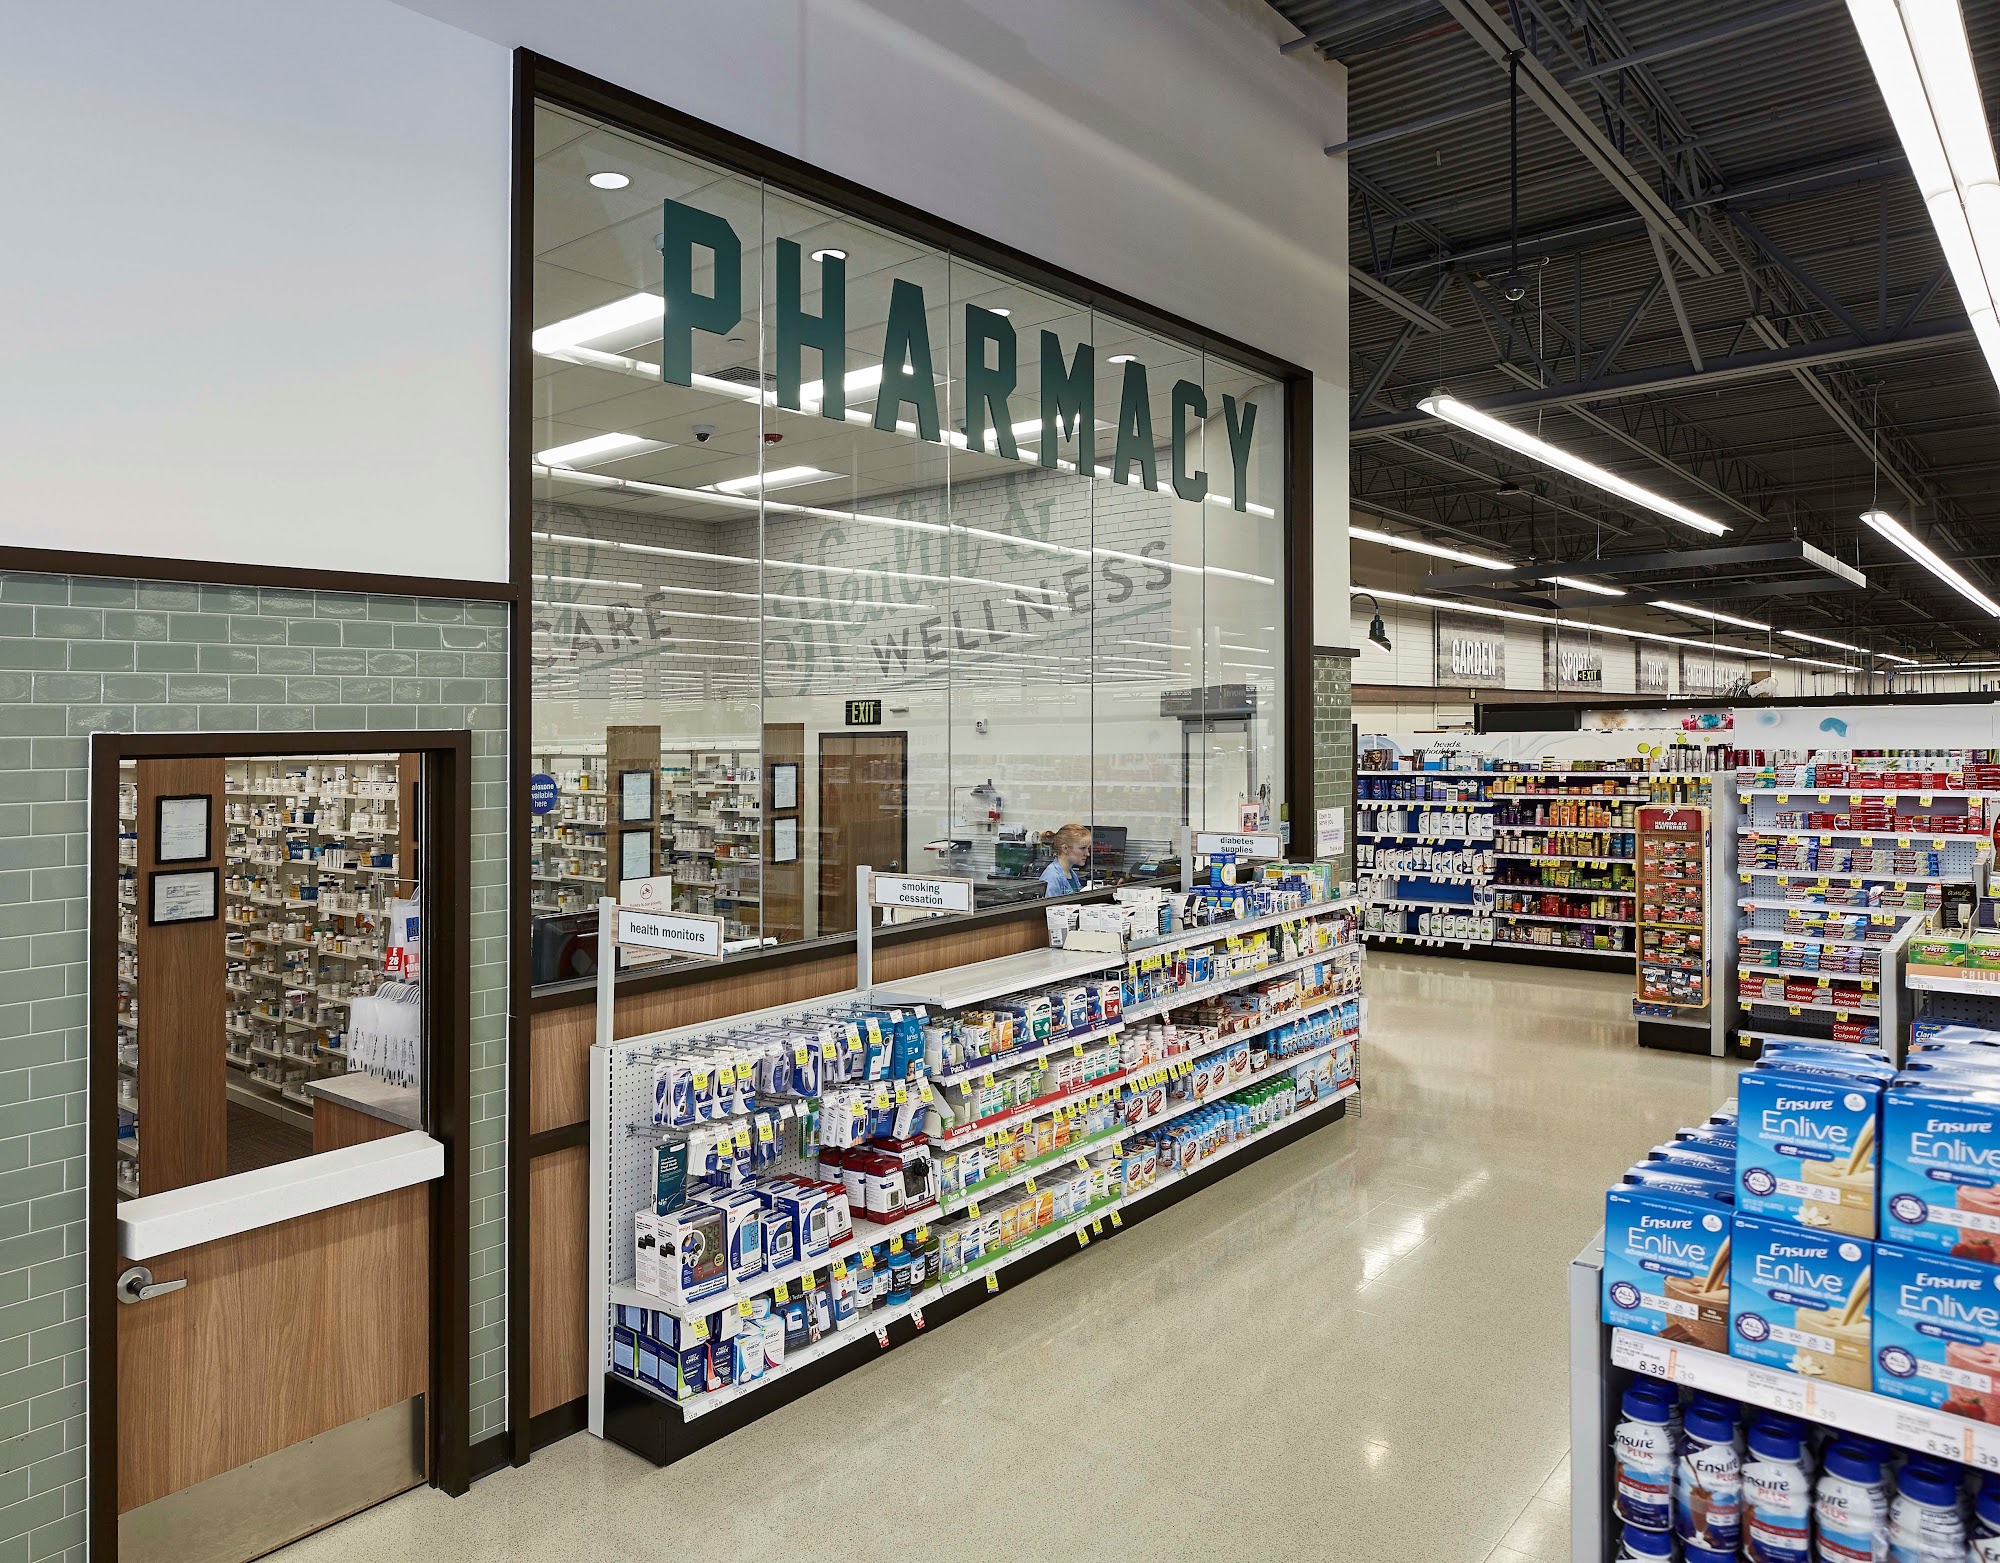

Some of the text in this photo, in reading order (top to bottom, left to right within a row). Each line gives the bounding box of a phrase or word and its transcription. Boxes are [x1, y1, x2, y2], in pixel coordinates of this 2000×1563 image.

[663, 198, 1258, 512] PHARMACY
[764, 485, 981, 698] Health
[1001, 470, 1073, 562] &
[870, 540, 1171, 679] WELLNESS
[532, 592, 672, 666] CARE
[1452, 639, 1496, 676] GARDEN
[1582, 671, 1597, 681] EXIT
[1648, 660, 1663, 686] TOYS
[852, 701, 876, 724] EXIT
[1220, 837, 1254, 845] diabetes
[902, 882, 940, 894] smoking
[899, 894, 943, 905] cessation
[630, 922, 705, 942] health monitors
[392, 948, 397, 956] E
[1922, 945, 1950, 953] ZYRTEC
[389, 957, 399, 965] 28
[1961, 970, 2000, 982] CHILD
[1786, 985, 1812, 993] Colgate
[1834, 991, 1861, 999] Colgate
[1834, 1024, 1861, 1032] Colgate
[950, 1065, 965, 1074] Patch
[1776, 1098, 1834, 1111] Ensure
[951, 1124, 972, 1136] Lozenge
[1762, 1110, 1848, 1143] Enlive
[1927, 1119, 1992, 1133] Ensure
[1911, 1132, 2000, 1168] Enlive
[947, 1193, 959, 1202] Gum
[1641, 1216, 1693, 1229] Ensure
[1628, 1227, 1706, 1261] Enlive
[1770, 1243, 1828, 1258] Ensure
[948, 1270, 960, 1279] Gum
[1755, 1255, 1843, 1292] Enlive
[1916, 1273, 1982, 1290] Ensure
[1900, 1285, 1999, 1327] Enlive
[1639, 1360, 1665, 1375] 8.39
[1774, 1396, 1804, 1412] 8.39
[1627, 1447, 1653, 1459] PLUS
[1927, 1439, 1961, 1458] 8.39
[1696, 1458, 1739, 1473] Ensure
[1758, 1488, 1789, 1502] PLUS
